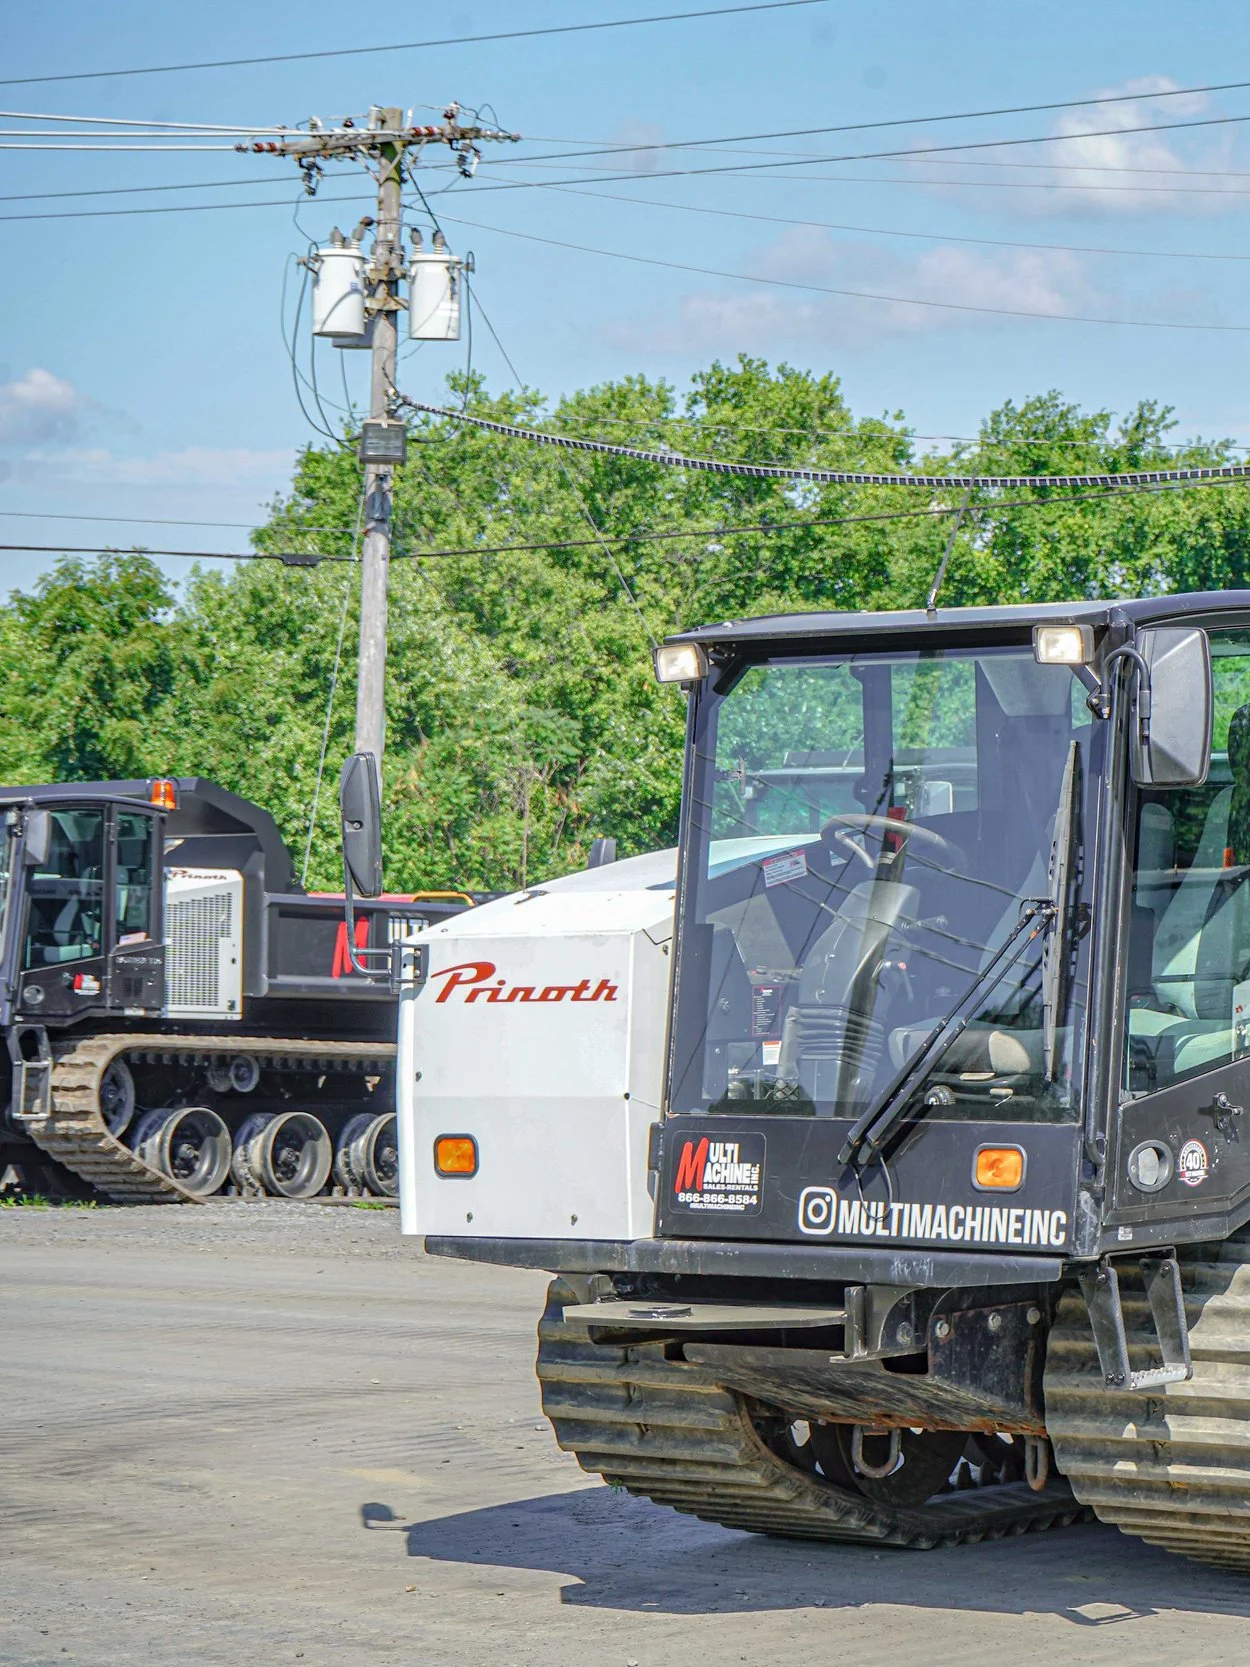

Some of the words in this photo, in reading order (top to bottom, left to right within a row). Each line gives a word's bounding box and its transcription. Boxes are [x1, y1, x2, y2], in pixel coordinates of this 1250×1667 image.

[430, 961, 619, 1004] Prinoth
[1186, 1152, 1201, 1171] 40
[677, 1192, 758, 1206] 866-866-8584
[837, 1200, 1067, 1247] MULTIMACHINEINC
